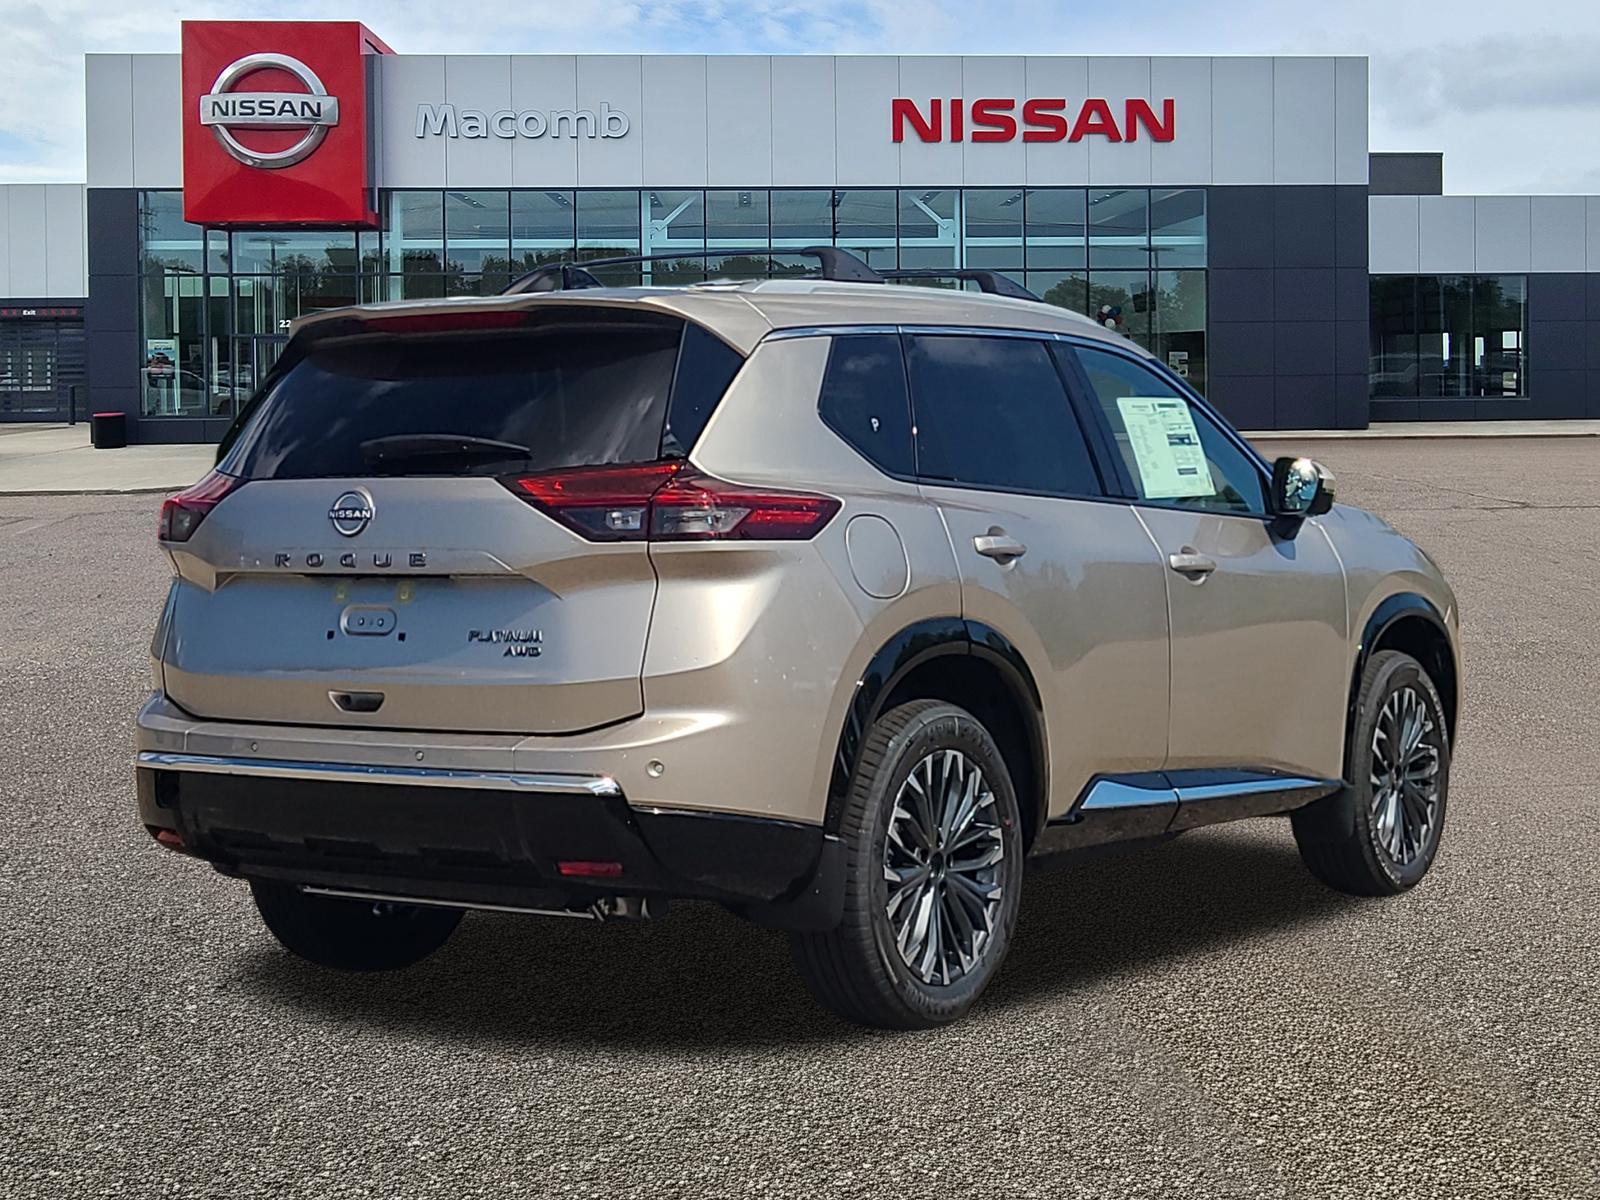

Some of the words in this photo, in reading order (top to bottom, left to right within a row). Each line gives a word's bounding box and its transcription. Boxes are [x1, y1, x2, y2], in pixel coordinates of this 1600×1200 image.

[211, 100, 322, 117] NISSAN
[415, 102, 630, 138] Macomb
[892, 98, 1175, 143] NISSAN
[329, 509, 371, 518] NISSAN
[274, 552, 427, 568] ROGUE
